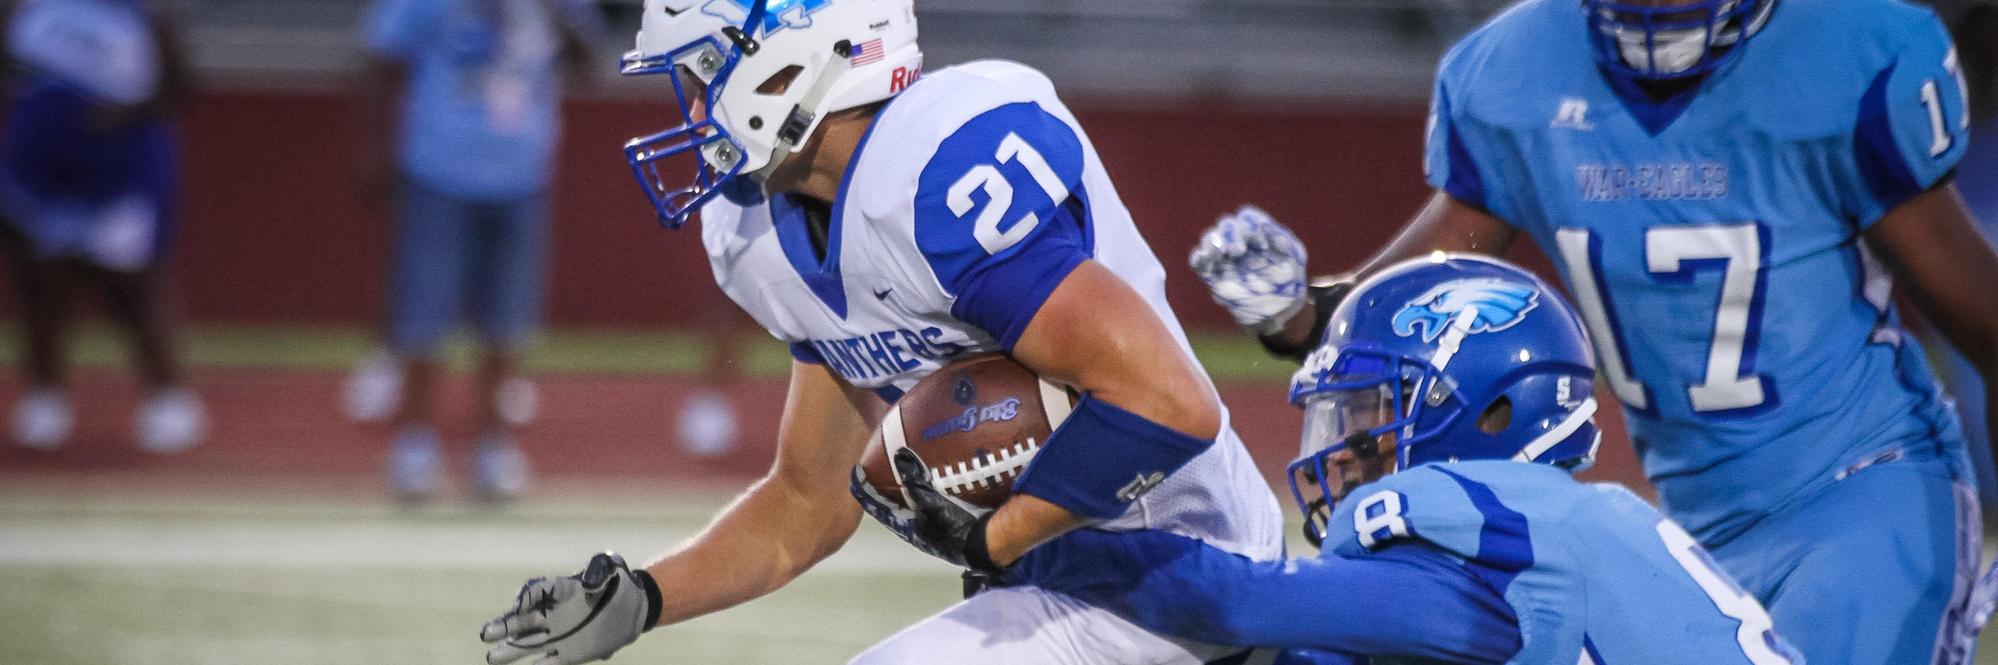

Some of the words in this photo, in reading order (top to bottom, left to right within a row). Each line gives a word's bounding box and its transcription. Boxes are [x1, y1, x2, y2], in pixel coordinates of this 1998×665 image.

[945, 130, 1069, 256] 21
[812, 326, 953, 380] ANTHERS
[1555, 222, 1766, 412] 17
[1353, 489, 1409, 548] 8
